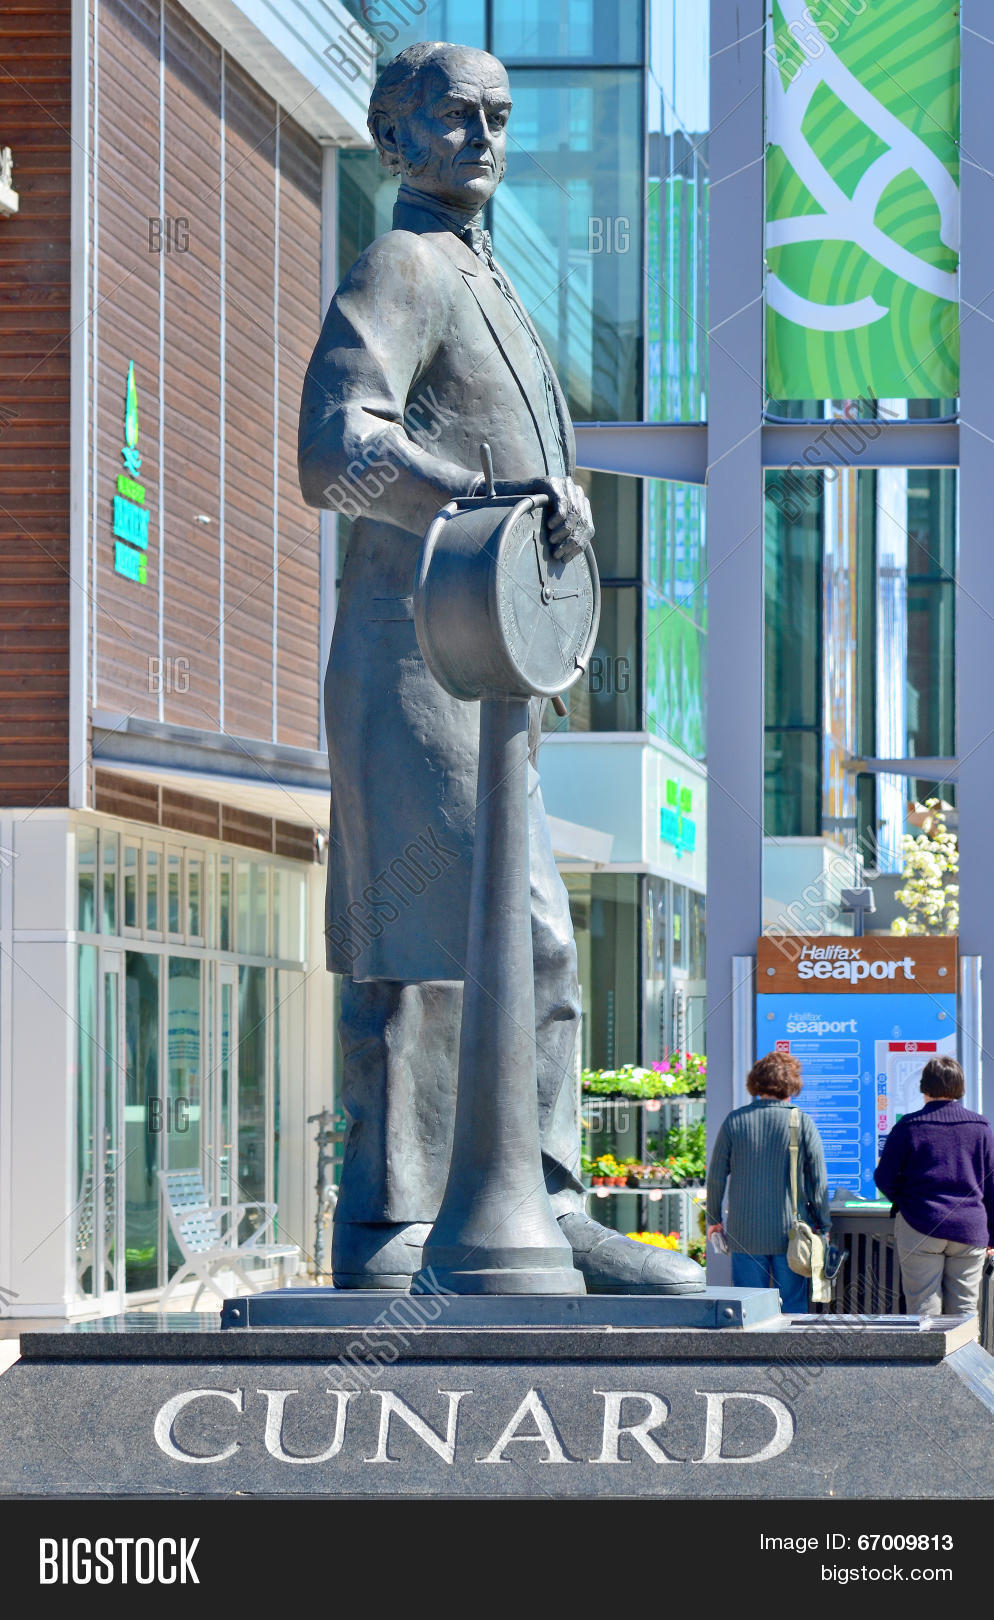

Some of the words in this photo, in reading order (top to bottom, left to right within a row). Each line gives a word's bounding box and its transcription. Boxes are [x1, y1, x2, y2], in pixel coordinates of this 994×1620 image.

[800, 945, 861, 960] Halifax
[797, 957, 916, 985] seaport
[786, 1018, 858, 1036] seaport
[153, 1387, 797, 1466] CUNARD
